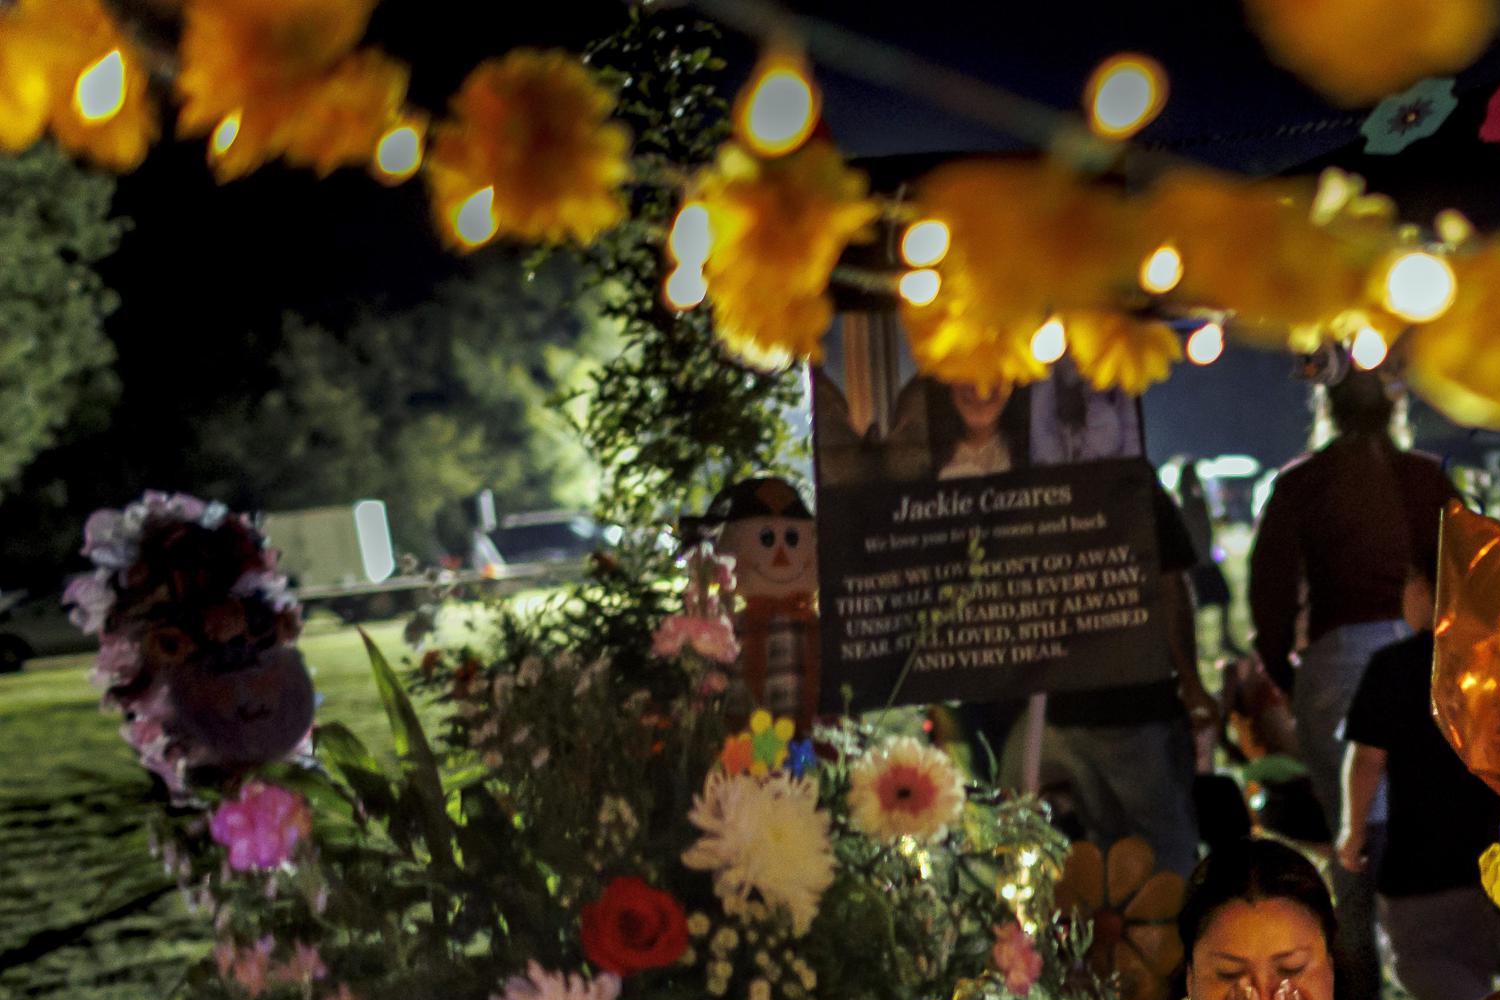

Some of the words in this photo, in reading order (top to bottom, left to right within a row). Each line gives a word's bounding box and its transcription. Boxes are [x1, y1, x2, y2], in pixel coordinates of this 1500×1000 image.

[893, 490, 973, 522] Jackie
[979, 484, 1072, 512] Cazares
[934, 561, 976, 581] LOV
[1041, 552, 1073, 574] GO
[835, 594, 886, 617] THEY
[1007, 577, 1033, 597] US
[1036, 570, 1098, 595] EVERY
[1060, 587, 1141, 615] ALWAYS
[911, 651, 956, 672] AND
[956, 647, 1007, 669] VERY
